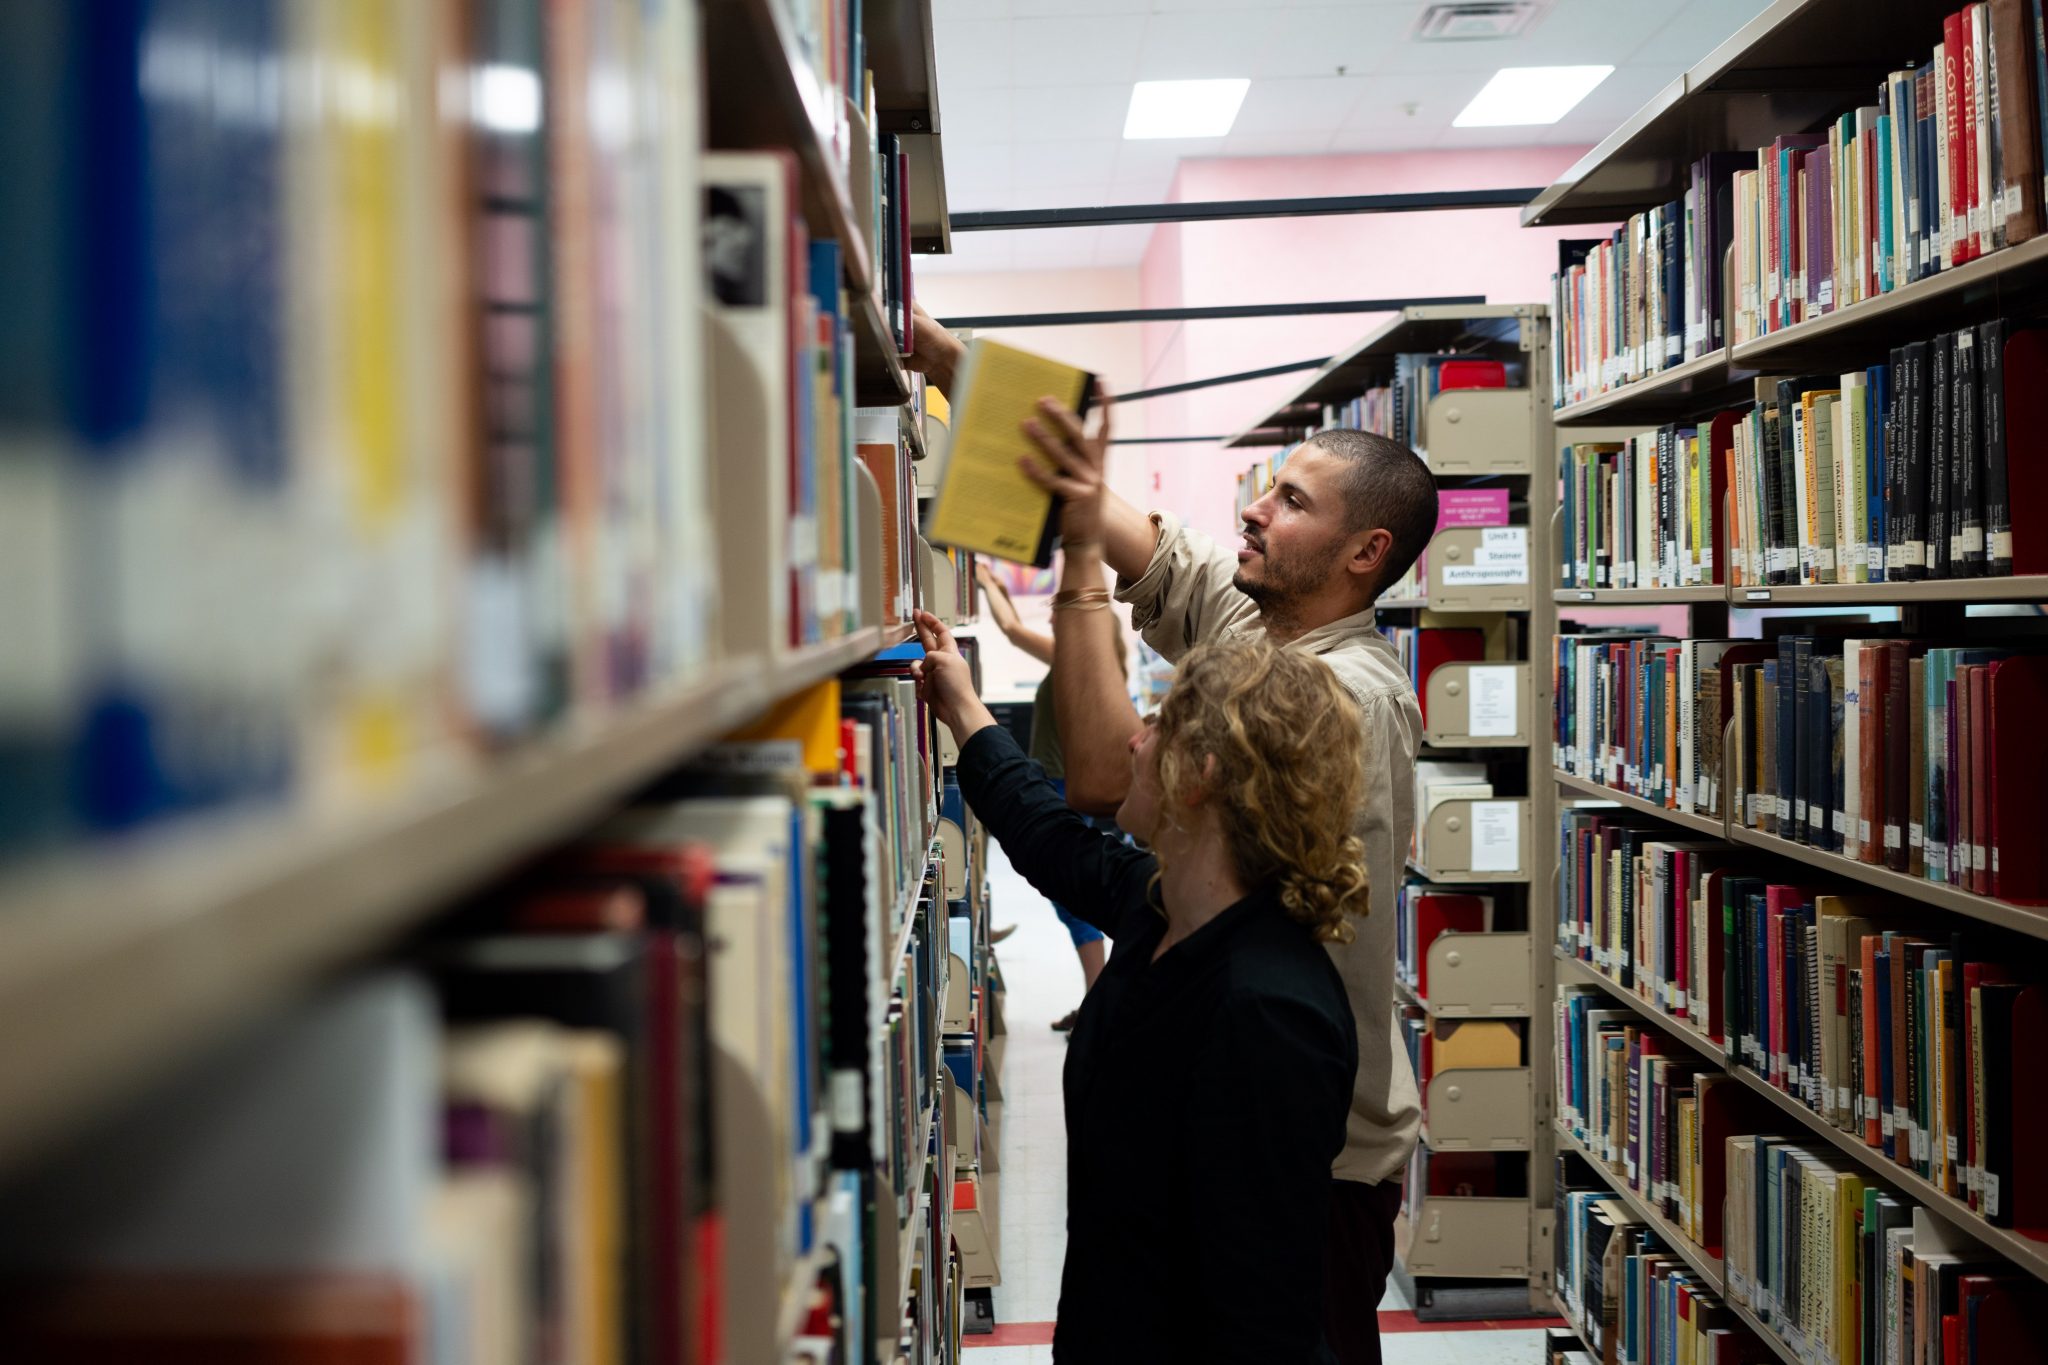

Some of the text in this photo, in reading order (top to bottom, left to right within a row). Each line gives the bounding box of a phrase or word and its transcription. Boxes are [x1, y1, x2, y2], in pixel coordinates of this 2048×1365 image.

[1946, 56, 1958, 142] GOETHE
[1963, 46, 1975, 134] GOETHE
[1937, 112, 1944, 128] ON
[1896, 395, 1904, 429] Poetry
[1912, 396, 1920, 426] Italian
[1938, 414, 1943, 425] on
[1952, 407, 1960, 436] Plays
[1910, 428, 1918, 465] Journey
[1952, 460, 1960, 484] Epic
[1488, 532, 1508, 540] Unit
[1449, 569, 1522, 578] Anthroposophy
[1909, 1053, 1914, 1067] OF
[1974, 1087, 1980, 1104] AS
